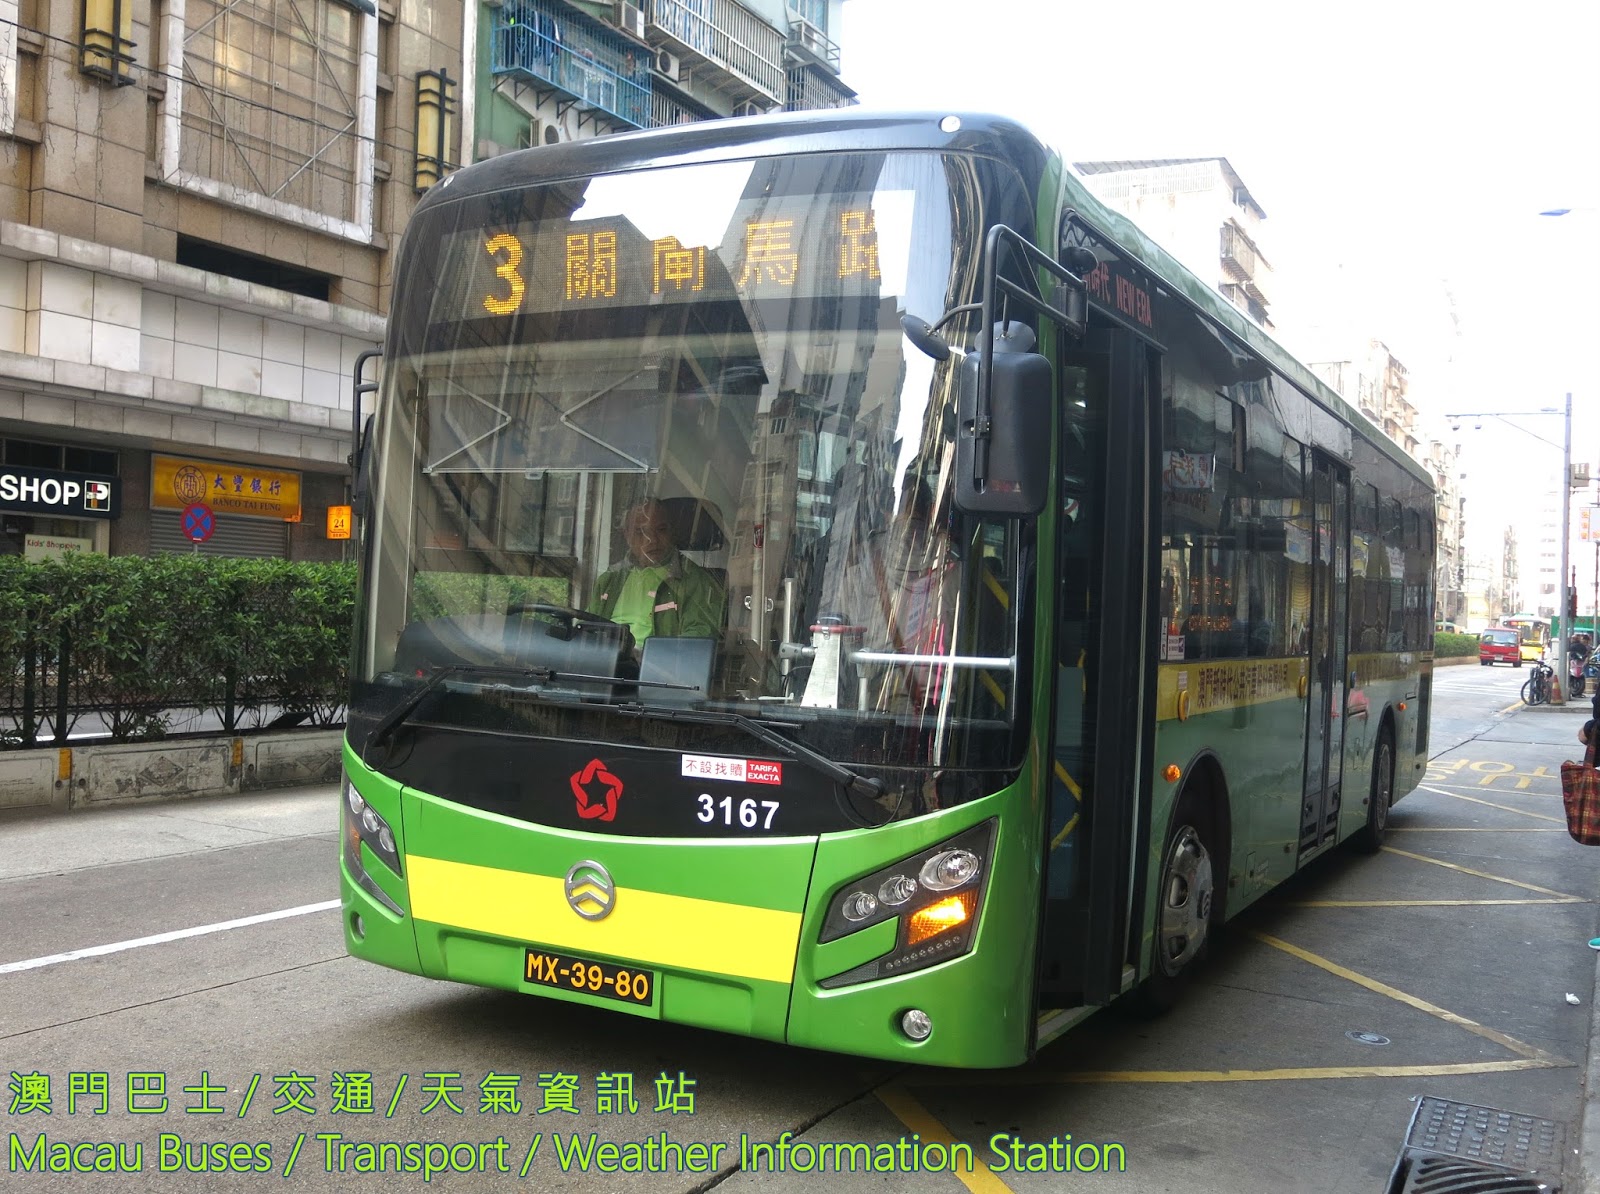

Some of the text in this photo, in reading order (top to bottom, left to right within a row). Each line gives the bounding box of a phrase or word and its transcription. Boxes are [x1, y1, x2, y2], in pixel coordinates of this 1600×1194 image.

[483, 233, 525, 315] 3
[1115, 273, 1135, 318] NEW
[1136, 288, 1152, 329] ERA
[0, 474, 81, 506] SHOP
[213, 497, 281, 511] BANCO TAI FUNG
[333, 518, 345, 528] 24
[747, 772, 780, 782] EXACTA
[749, 763, 779, 773] TARIFA
[697, 793, 780, 829] 3167
[527, 953, 649, 1000] MX-39-80
